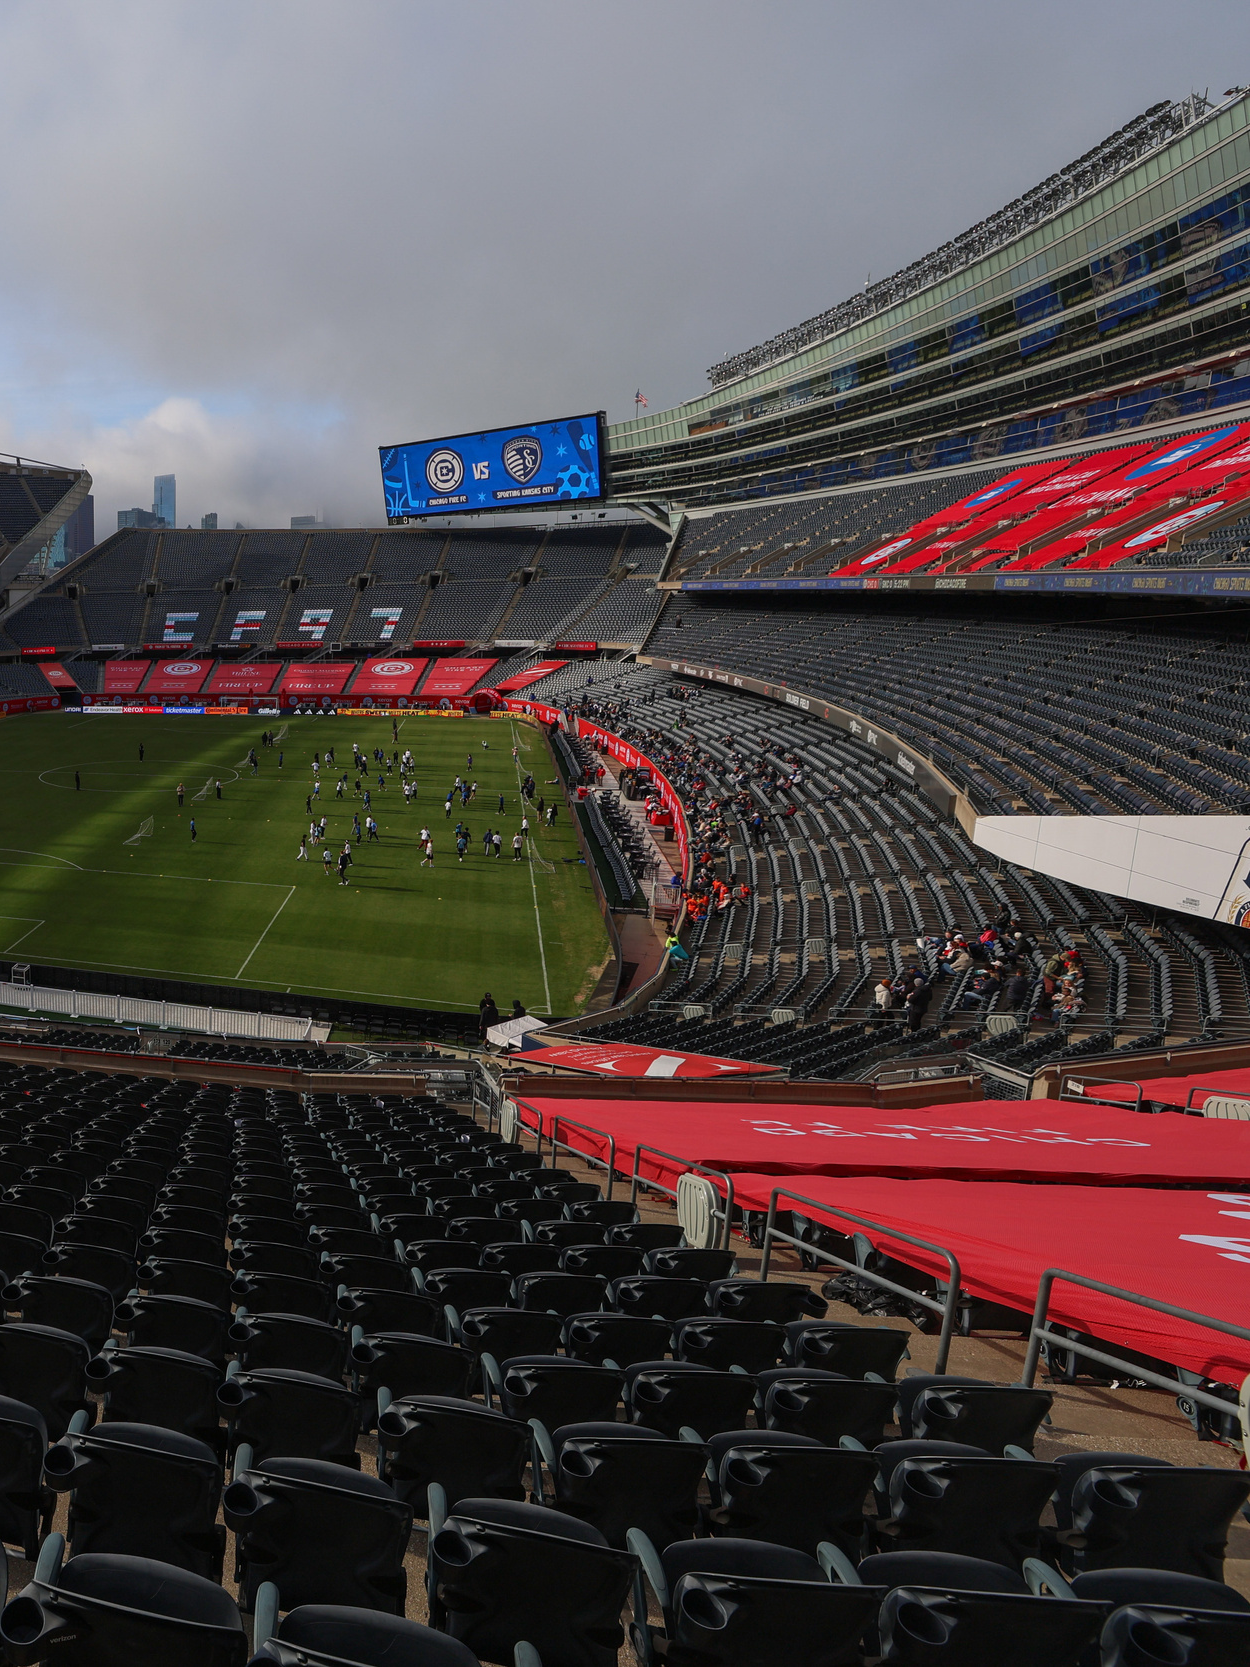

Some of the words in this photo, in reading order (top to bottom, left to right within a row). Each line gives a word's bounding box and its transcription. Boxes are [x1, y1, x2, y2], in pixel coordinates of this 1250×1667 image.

[472, 461, 490, 480] VS
[497, 490, 520, 499] SPORTING
[522, 488, 541, 496] KANSAS
[542, 486, 554, 494] CITY
[786, 693, 799, 705] SOLDIER
[800, 698, 809, 709] FIELD
[874, 1123, 1070, 1136] FIRE
[754, 1128, 1152, 1146] CHICAGO
[1183, 1402, 1190, 1412] 15
[50, 1634, 76, 1644] verizon
